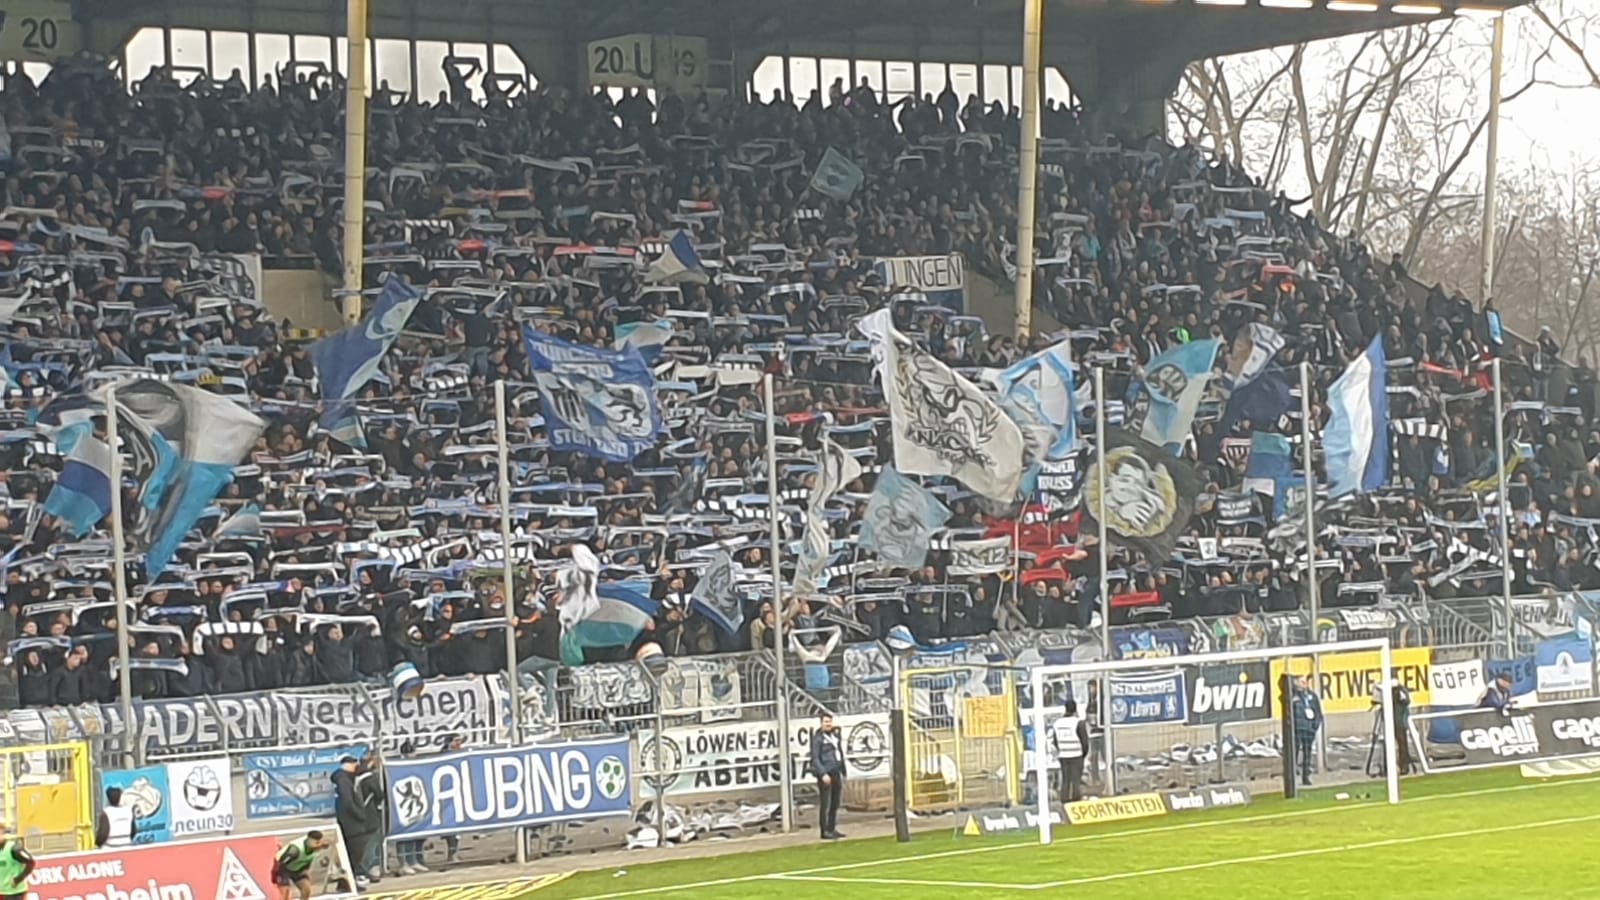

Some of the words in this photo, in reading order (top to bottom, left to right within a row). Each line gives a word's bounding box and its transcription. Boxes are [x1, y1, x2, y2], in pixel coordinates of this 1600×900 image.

[21, 17, 58, 49] 20
[594, 46, 624, 74] 20
[1433, 667, 1479, 690] GÖPP
[1193, 672, 1265, 713] bwin
[280, 688, 477, 724] Vierkrchen
[1460, 713, 1536, 755] capelli
[432, 750, 592, 825] AUBING
[1210, 788, 1245, 806] bwin
[1071, 798, 1163, 820] SPORTWETTEN
[1170, 792, 1205, 810] bwin
[174, 814, 234, 833] neun30
[983, 813, 1020, 831] bwin
[28, 866, 64, 885] ORK
[68, 860, 124, 881] ALONE
